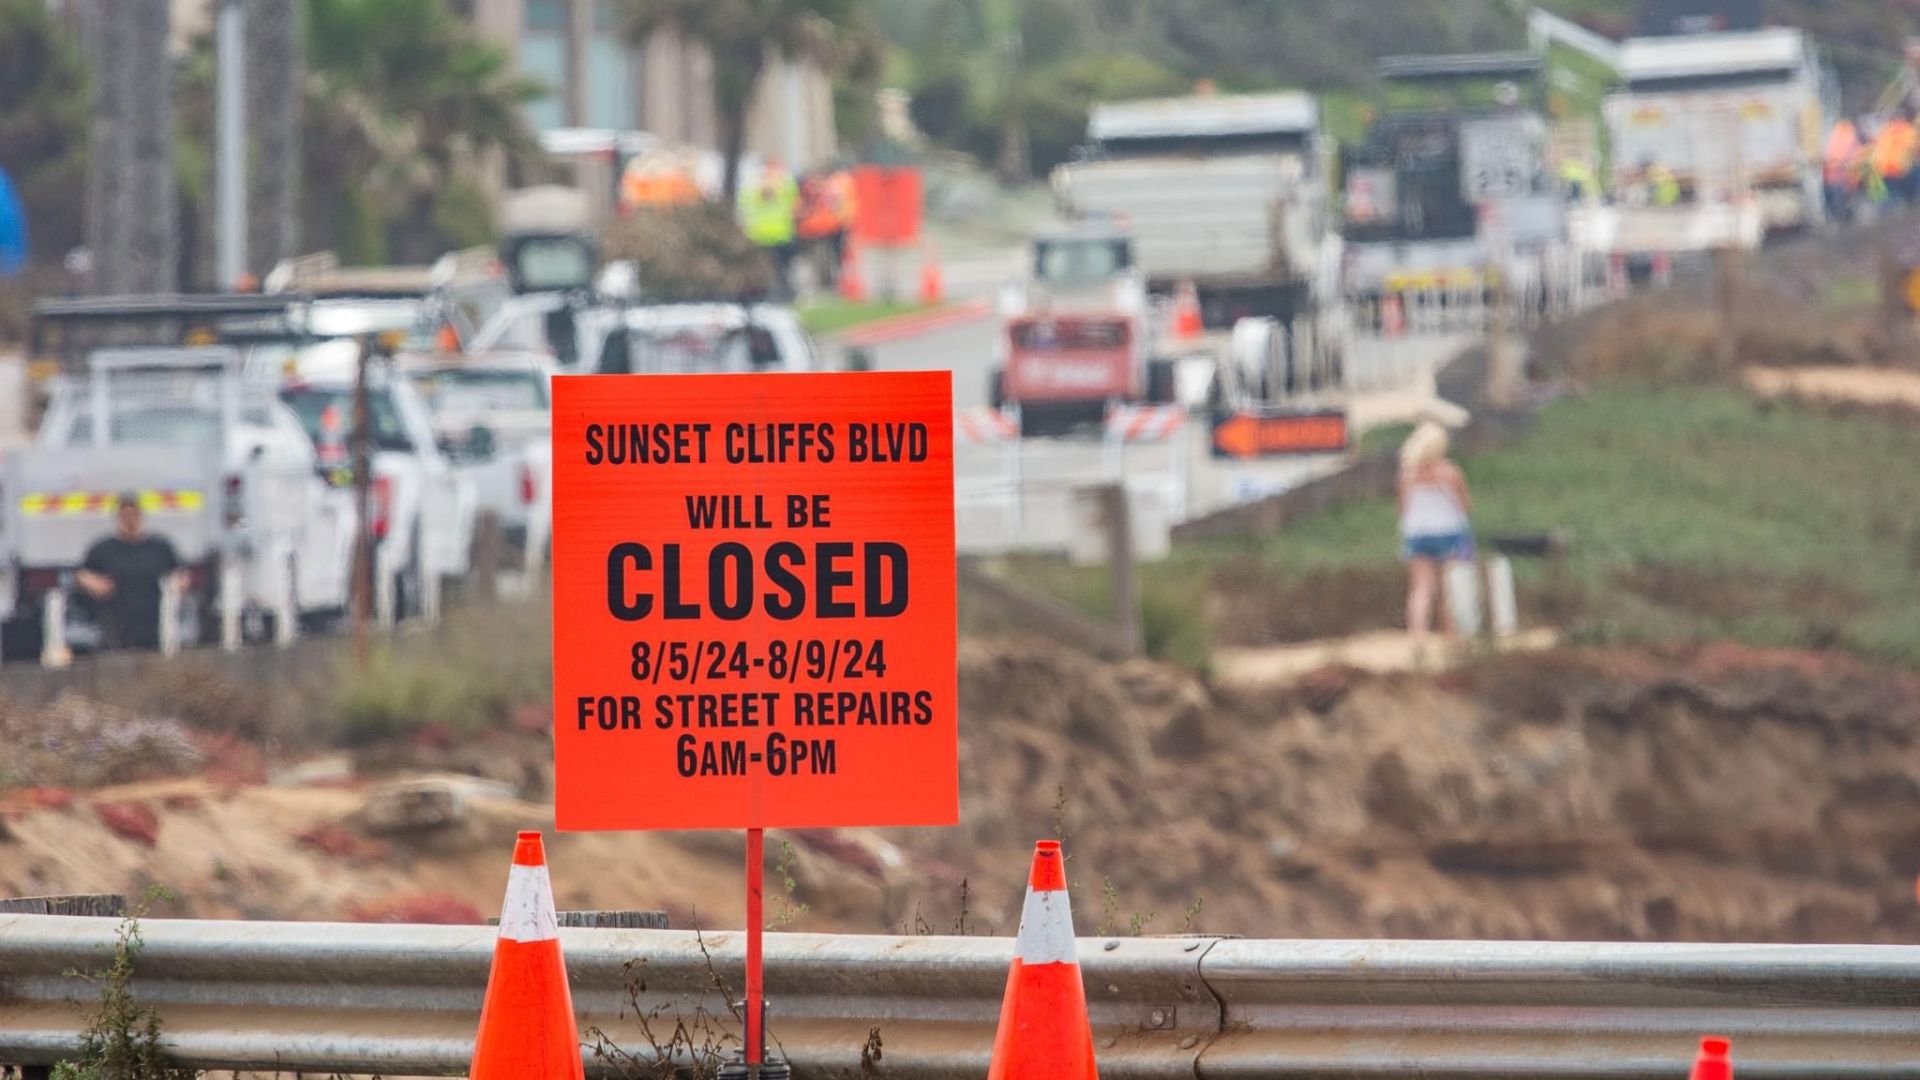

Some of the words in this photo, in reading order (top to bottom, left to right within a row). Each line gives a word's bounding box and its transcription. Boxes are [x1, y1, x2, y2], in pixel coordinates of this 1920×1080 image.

[586, 423, 711, 465] SUNSET
[726, 423, 835, 464] CLIFFS
[849, 423, 928, 462] BLVD
[686, 495, 772, 529] WILL
[788, 495, 831, 528] BE
[607, 541, 909, 621] CLOSED
[631, 640, 887, 683] 8/5/24-8/9/24
[578, 696, 641, 730] FOR
[656, 693, 780, 728] STREET
[795, 691, 933, 725] REPAIRS
[677, 732, 836, 777] 6AM-6PM
